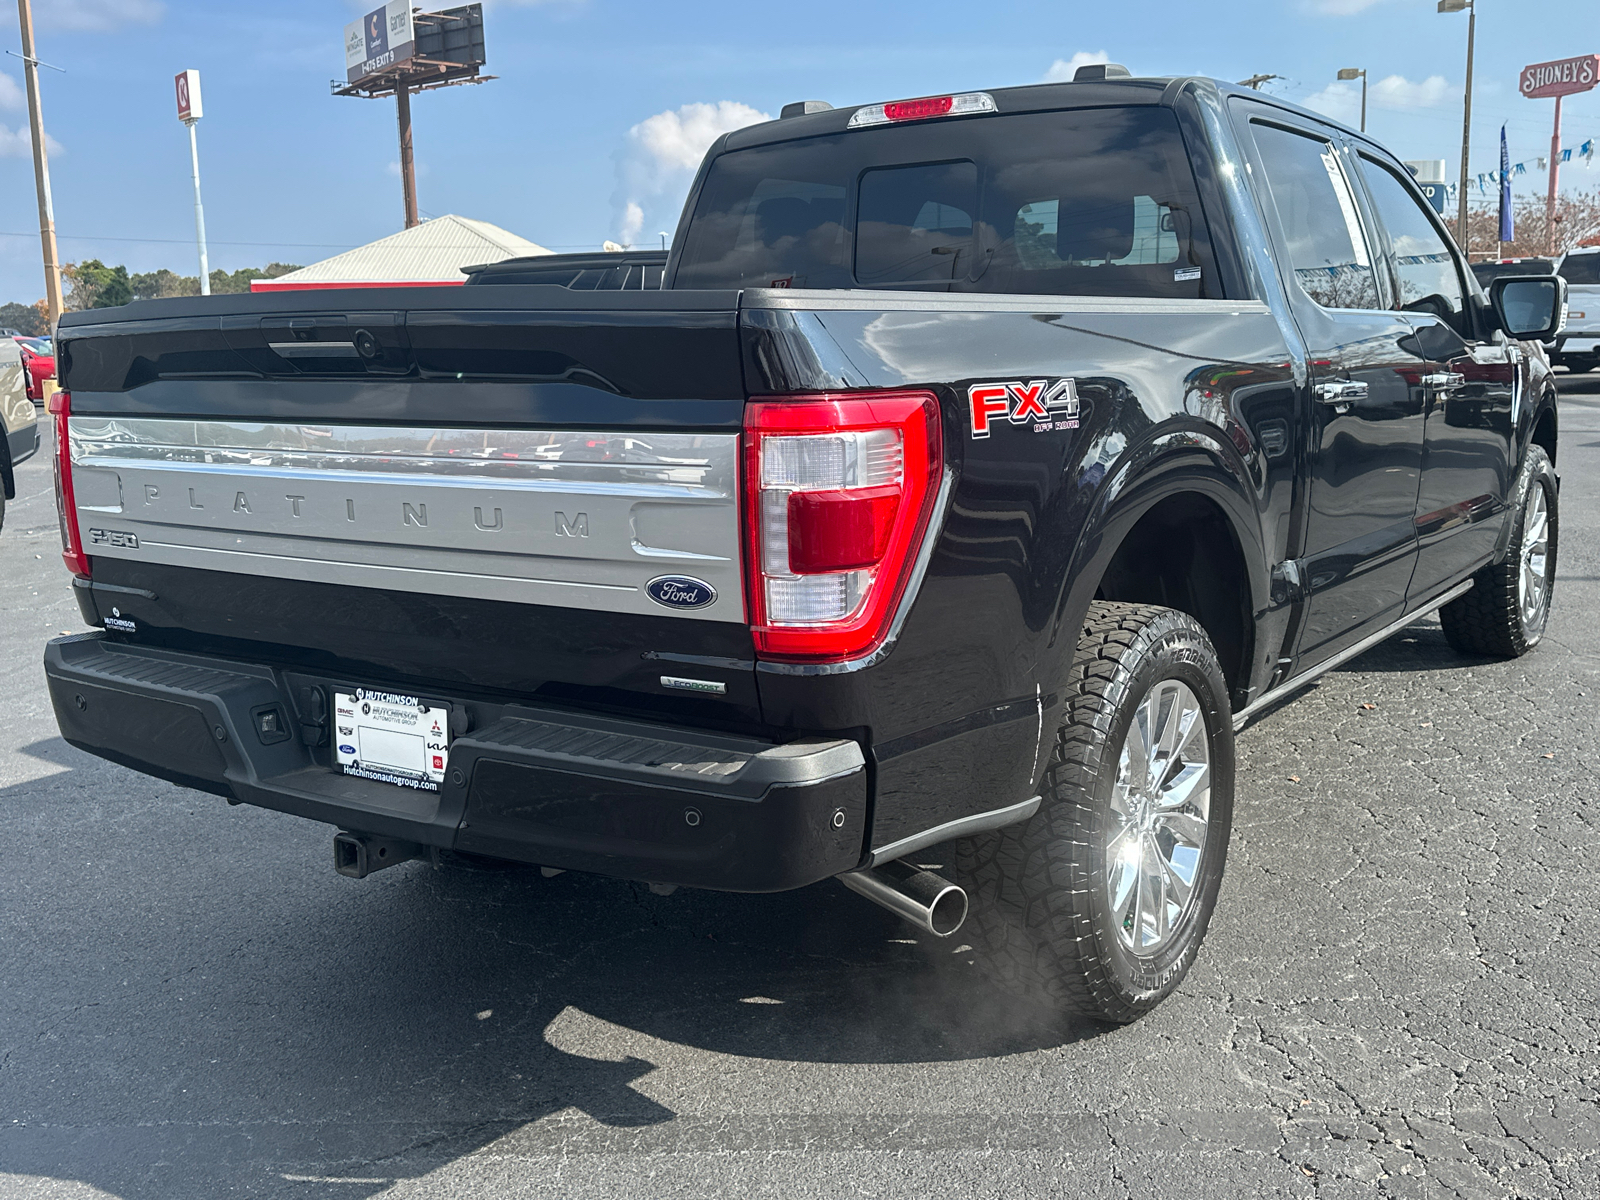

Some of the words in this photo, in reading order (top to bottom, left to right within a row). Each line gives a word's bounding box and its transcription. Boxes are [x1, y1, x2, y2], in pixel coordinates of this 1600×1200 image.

[376, 51, 389, 67] EXIT
[390, 50, 395, 62] 9
[1523, 59, 1593, 92] SHONEY'S
[968, 378, 1080, 440] FX4
[144, 483, 590, 539] PLATINUM
[89, 527, 139, 550] F-150
[660, 581, 699, 603] Ford
[103, 617, 136, 628] HUTCHINSON
[365, 690, 419, 706] HUTCHINSON
[337, 707, 354, 715] GMC
[343, 764, 438, 791] Hutchinsonautogroup.com
